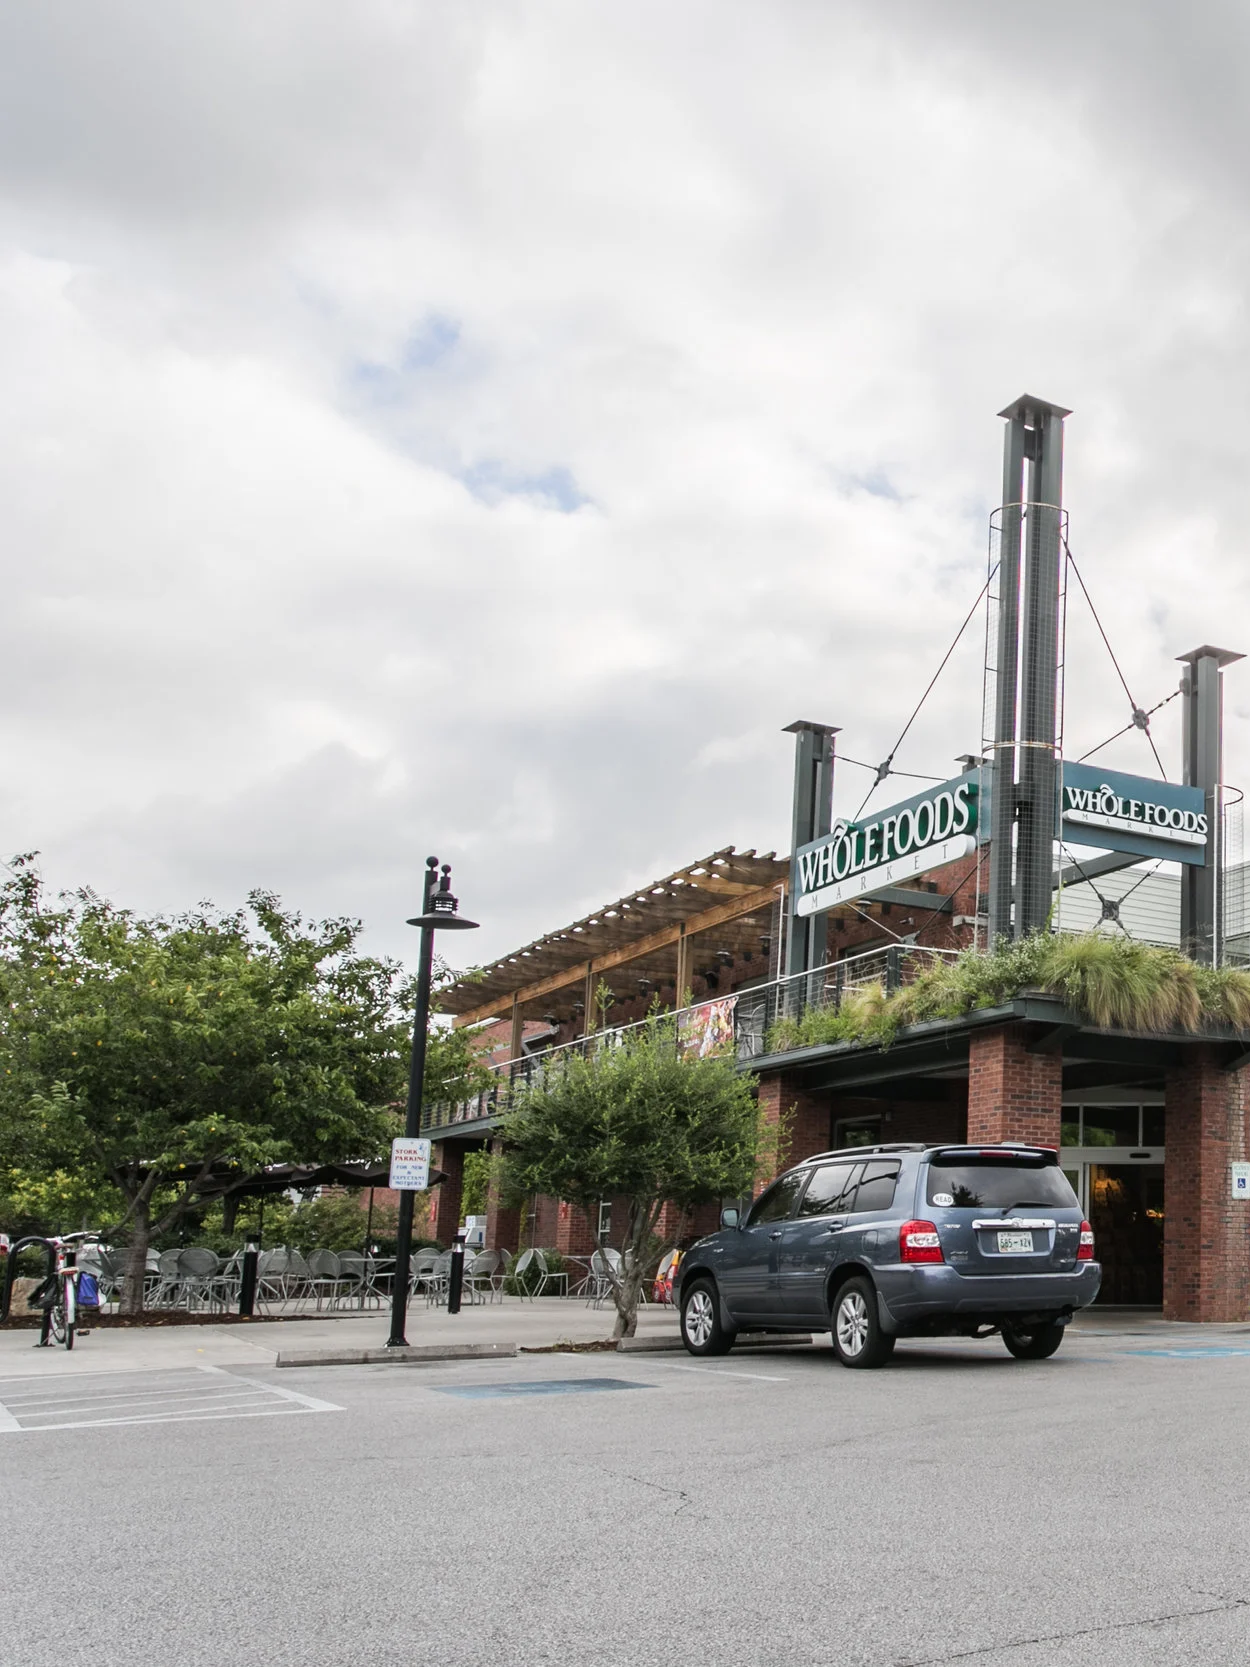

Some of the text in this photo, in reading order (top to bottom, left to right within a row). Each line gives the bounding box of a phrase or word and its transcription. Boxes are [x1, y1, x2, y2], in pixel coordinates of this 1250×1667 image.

[1065, 784, 1209, 834] WHOLE FOODS
[1082, 813, 1195, 841] MARKET
[797, 783, 970, 894] WHOLE FOODS
[810, 843, 949, 909] MARKET
